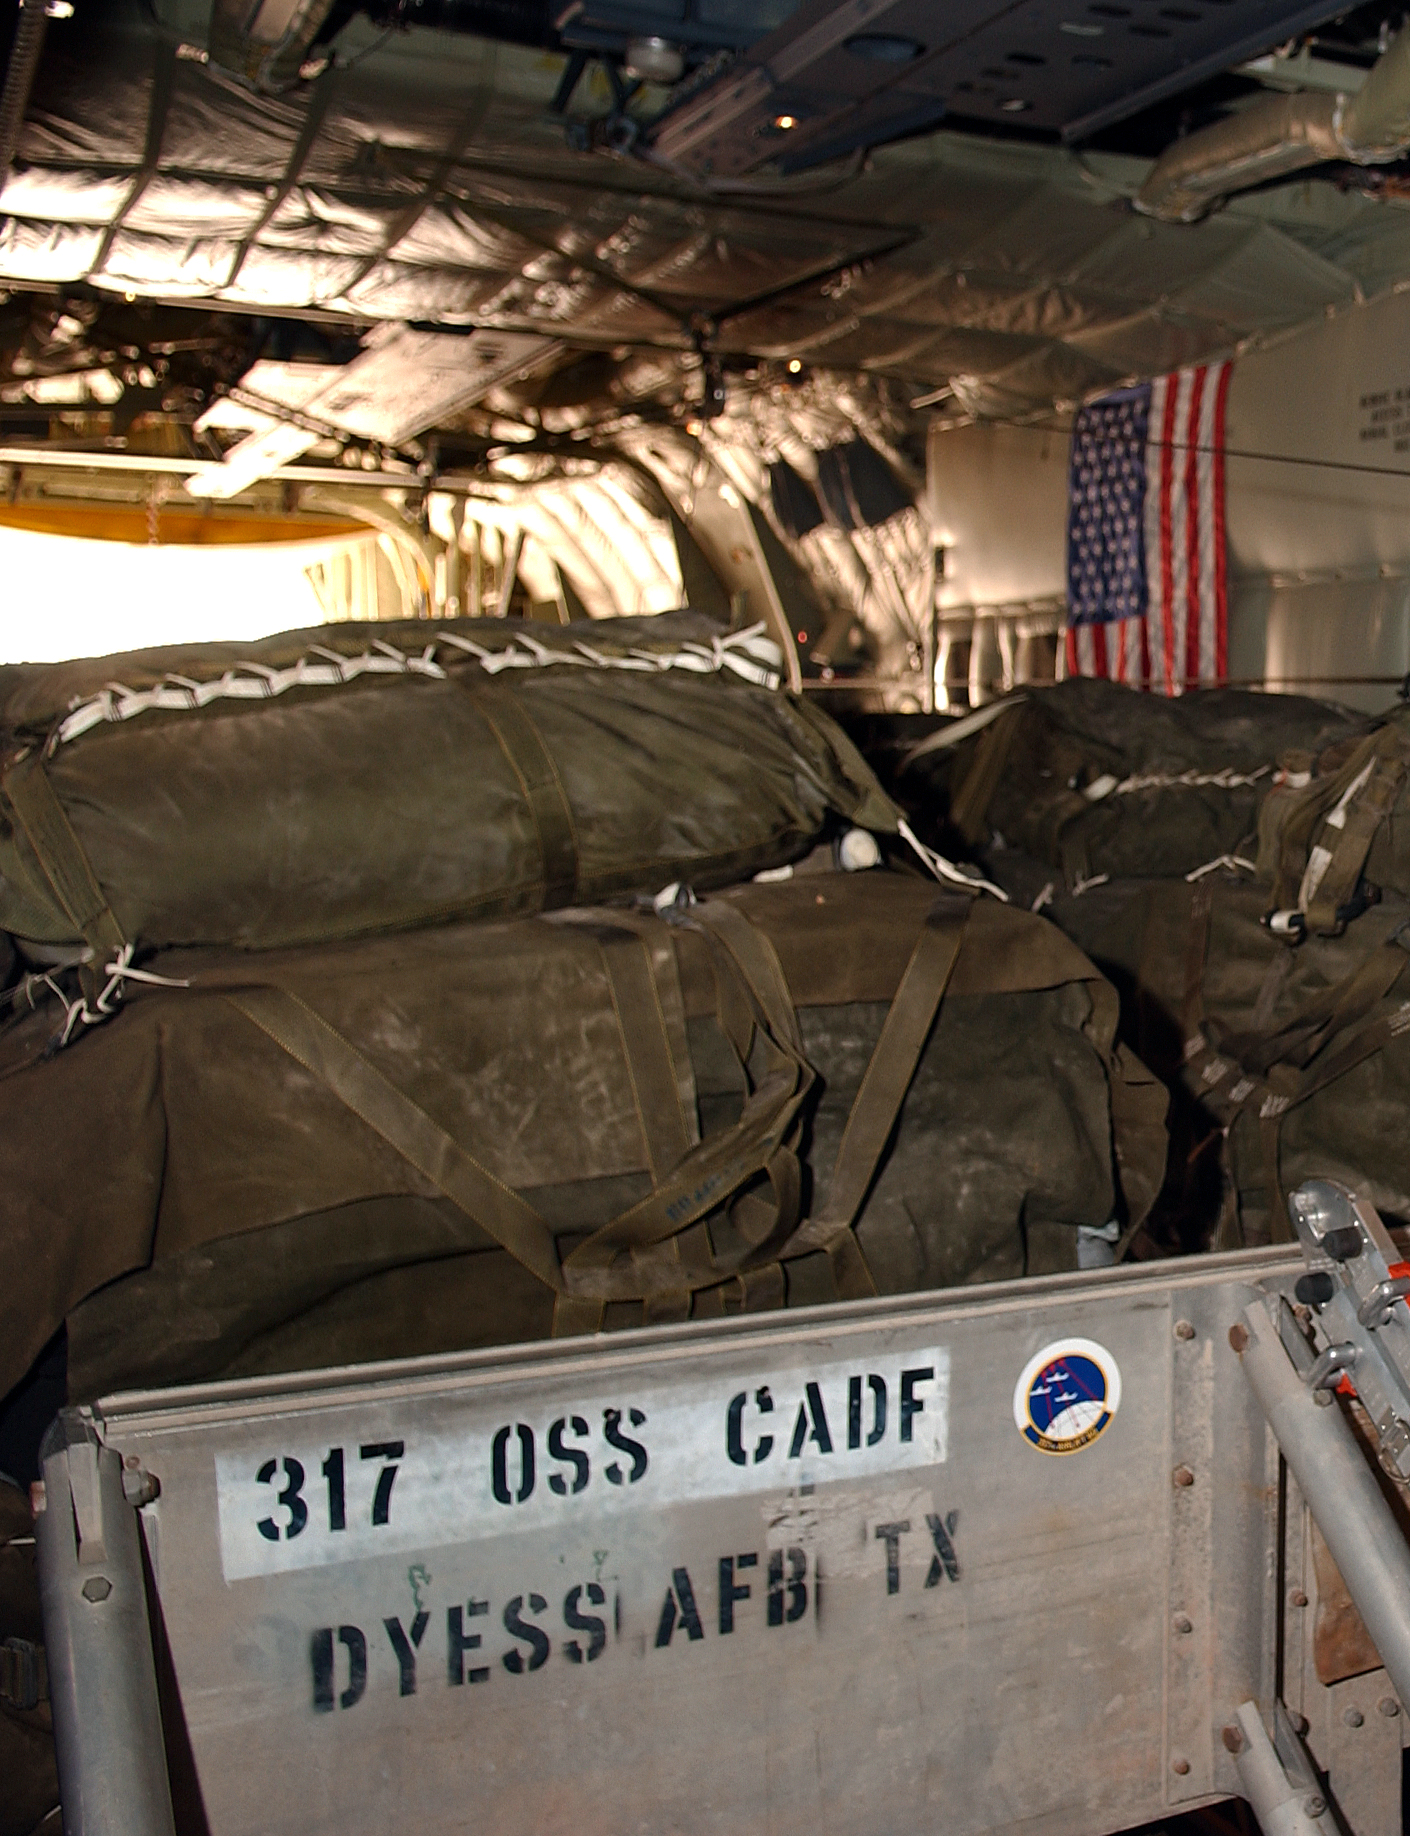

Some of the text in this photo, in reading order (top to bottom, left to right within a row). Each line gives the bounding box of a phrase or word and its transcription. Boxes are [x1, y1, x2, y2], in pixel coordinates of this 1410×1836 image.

[255, 1366, 935, 1543] 317 OSS CADF
[311, 1512, 962, 1716] DYESS AFB TX
